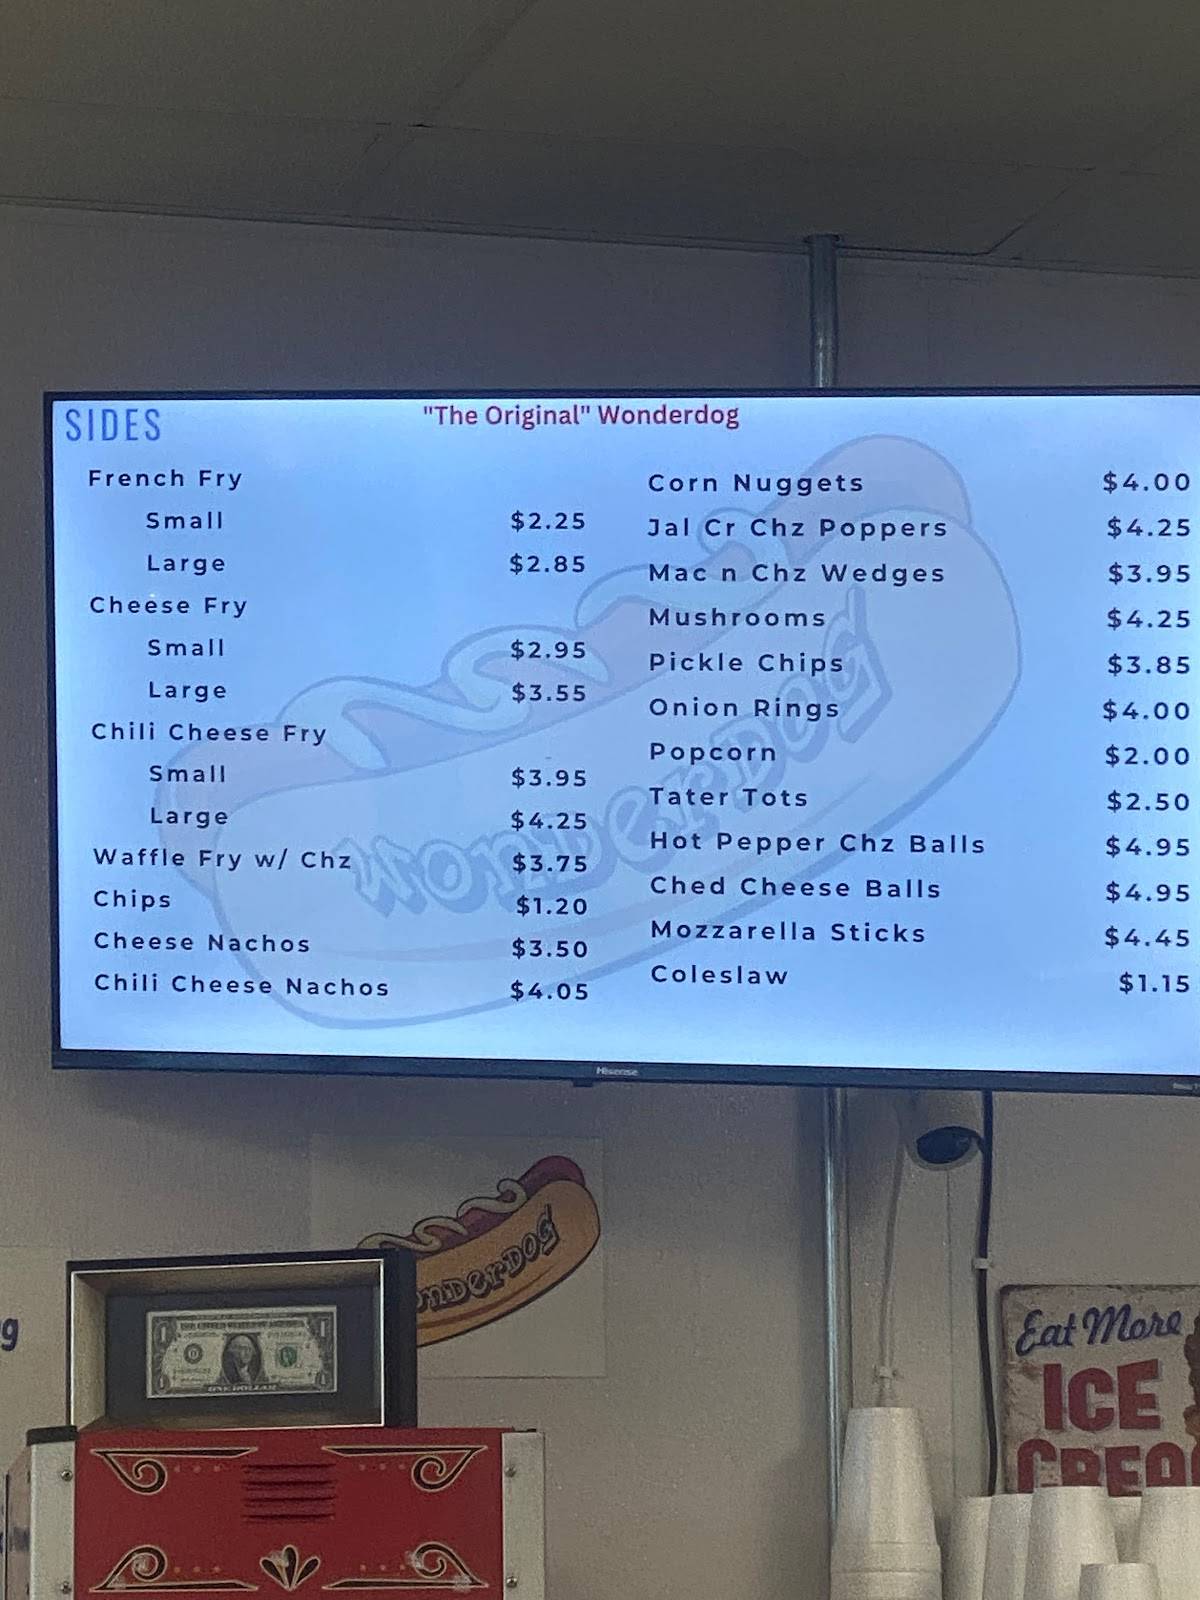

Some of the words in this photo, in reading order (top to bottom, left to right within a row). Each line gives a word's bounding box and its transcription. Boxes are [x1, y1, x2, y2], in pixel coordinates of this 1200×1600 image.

[64, 407, 162, 442] SIDES
[423, 404, 479, 427] "The
[484, 403, 591, 431] Original"
[598, 403, 740, 431] Wonderdog
[89, 468, 184, 487] French
[199, 469, 242, 491] Fry
[648, 474, 717, 492] Corn
[734, 473, 863, 497] Nuggets
[1103, 470, 1190, 495] $4.00
[146, 511, 222, 530] Small
[511, 509, 585, 533] $2.25
[647, 517, 689, 537] Jal
[704, 518, 735, 537] Cr
[750, 517, 804, 537] Chz
[820, 518, 947, 542] Poppers
[1107, 515, 1190, 540] $4.25
[147, 554, 225, 576] Large
[510, 552, 585, 576] $2.85
[649, 563, 706, 582] Mac
[722, 567, 736, 582] n
[752, 563, 806, 582] Chz
[821, 563, 944, 587] Wedges
[1108, 561, 1190, 585] $3.95
[90, 595, 190, 614] Cheese
[204, 597, 247, 619] Fry
[649, 607, 825, 627] Mushrooms
[1107, 607, 1190, 631] $4.25
[148, 638, 223, 657] Small
[511, 638, 586, 662] $2.95
[650, 651, 743, 672] Pickle
[758, 652, 843, 677] Chips
[1108, 653, 1190, 677] $3.85
[149, 681, 227, 703] Large
[512, 681, 586, 705] $3.55
[649, 696, 738, 717] Onion
[754, 697, 839, 722] Rings
[1103, 698, 1190, 723] $4.00
[91, 721, 154, 741] Chili
[169, 723, 269, 741] Cheese
[284, 724, 326, 747] Fry
[650, 742, 776, 766] Popcorn
[1105, 743, 1189, 768] $2.00
[149, 764, 225, 783] Small
[512, 766, 587, 789] $3.95
[649, 787, 729, 806] Tater
[742, 788, 807, 807] Tots
[1107, 789, 1190, 813] $2.50
[151, 807, 228, 829] Large
[511, 809, 587, 832] $4.25
[650, 831, 702, 850] Hot
[717, 832, 825, 856] Pepper
[840, 833, 894, 853] Chz
[910, 834, 985, 854] Balls
[1106, 835, 1190, 858] $4.95
[93, 848, 185, 867] Waffle
[199, 850, 242, 872] Fry
[255, 847, 288, 870] w/
[301, 851, 351, 869] Chz
[512, 851, 587, 875] $3.75
[650, 875, 725, 895] Ched
[740, 876, 850, 897] Cheese
[866, 879, 940, 899] Balls
[1106, 880, 1189, 904] $4.95
[94, 888, 170, 913] Chips
[516, 894, 587, 917] $1.20
[94, 931, 194, 951] Cheese
[208, 934, 310, 953] Nachos
[651, 920, 815, 941] Mozzarella
[831, 922, 925, 943] Sticks
[1105, 925, 1190, 949] $4.45
[512, 937, 588, 960] $3.50
[94, 972, 157, 992] Chili
[171, 975, 272, 994] Cheese
[286, 977, 388, 996] Nachos
[651, 964, 788, 985] Coleslaw
[1119, 971, 1190, 995] $1.15
[510, 979, 588, 1002] $4.05
[1015, 1309, 1076, 1356] Eat
[1082, 1303, 1182, 1345] More
[1043, 1358, 1161, 1431] ICE
[1017, 1438, 1200, 1497] CREA
